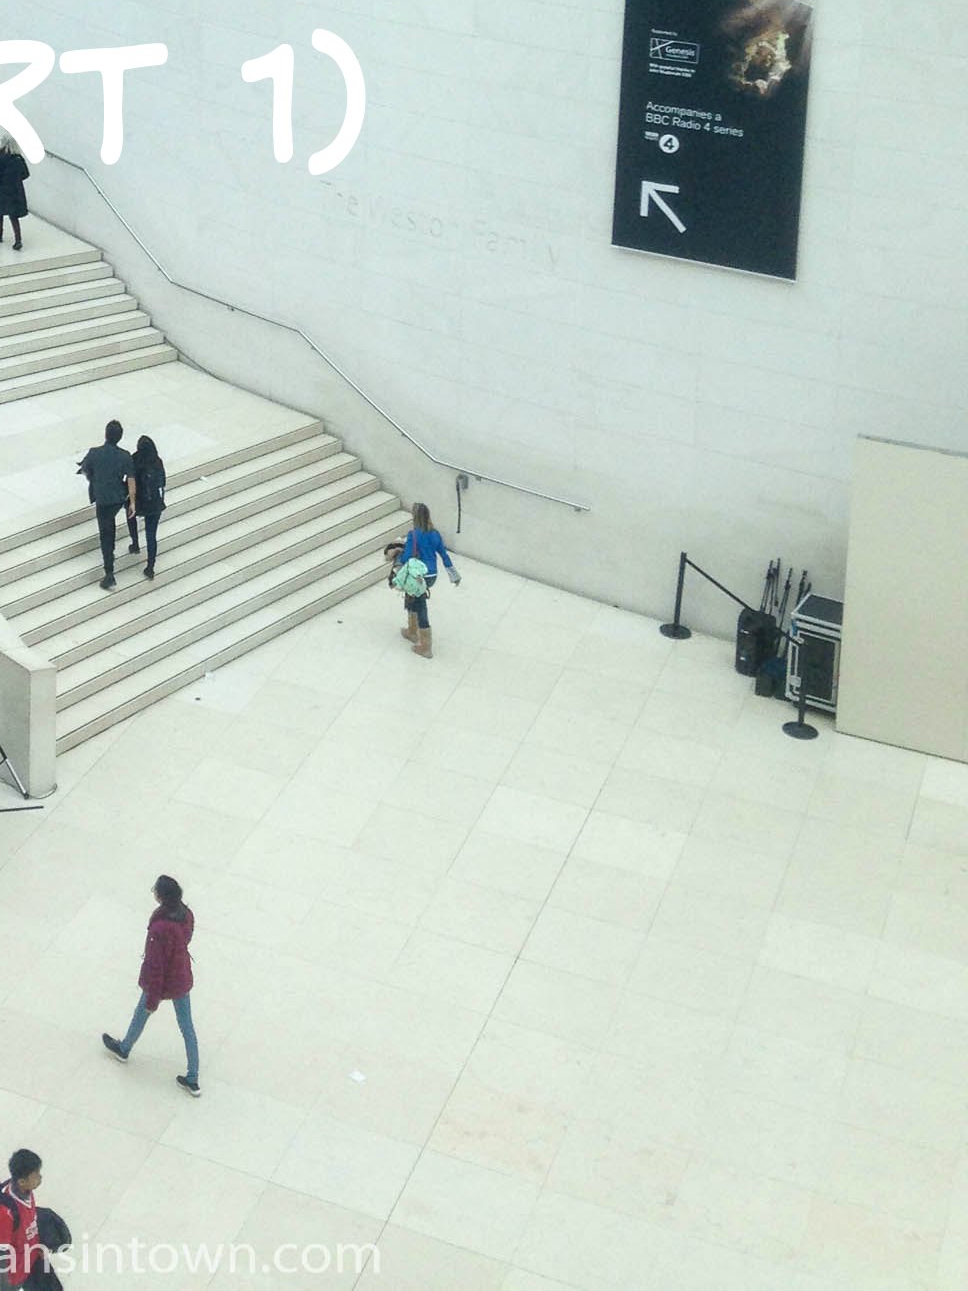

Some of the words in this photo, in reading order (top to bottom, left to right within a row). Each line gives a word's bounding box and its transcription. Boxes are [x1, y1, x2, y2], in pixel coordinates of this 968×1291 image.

[665, 45, 696, 57] Genesis
[646, 101, 713, 121] Accompanies
[714, 113, 722, 121] a
[645, 112, 670, 126] BBC
[672, 116, 702, 131] Radio
[703, 122, 711, 132] 4
[713, 124, 744, 138] series
